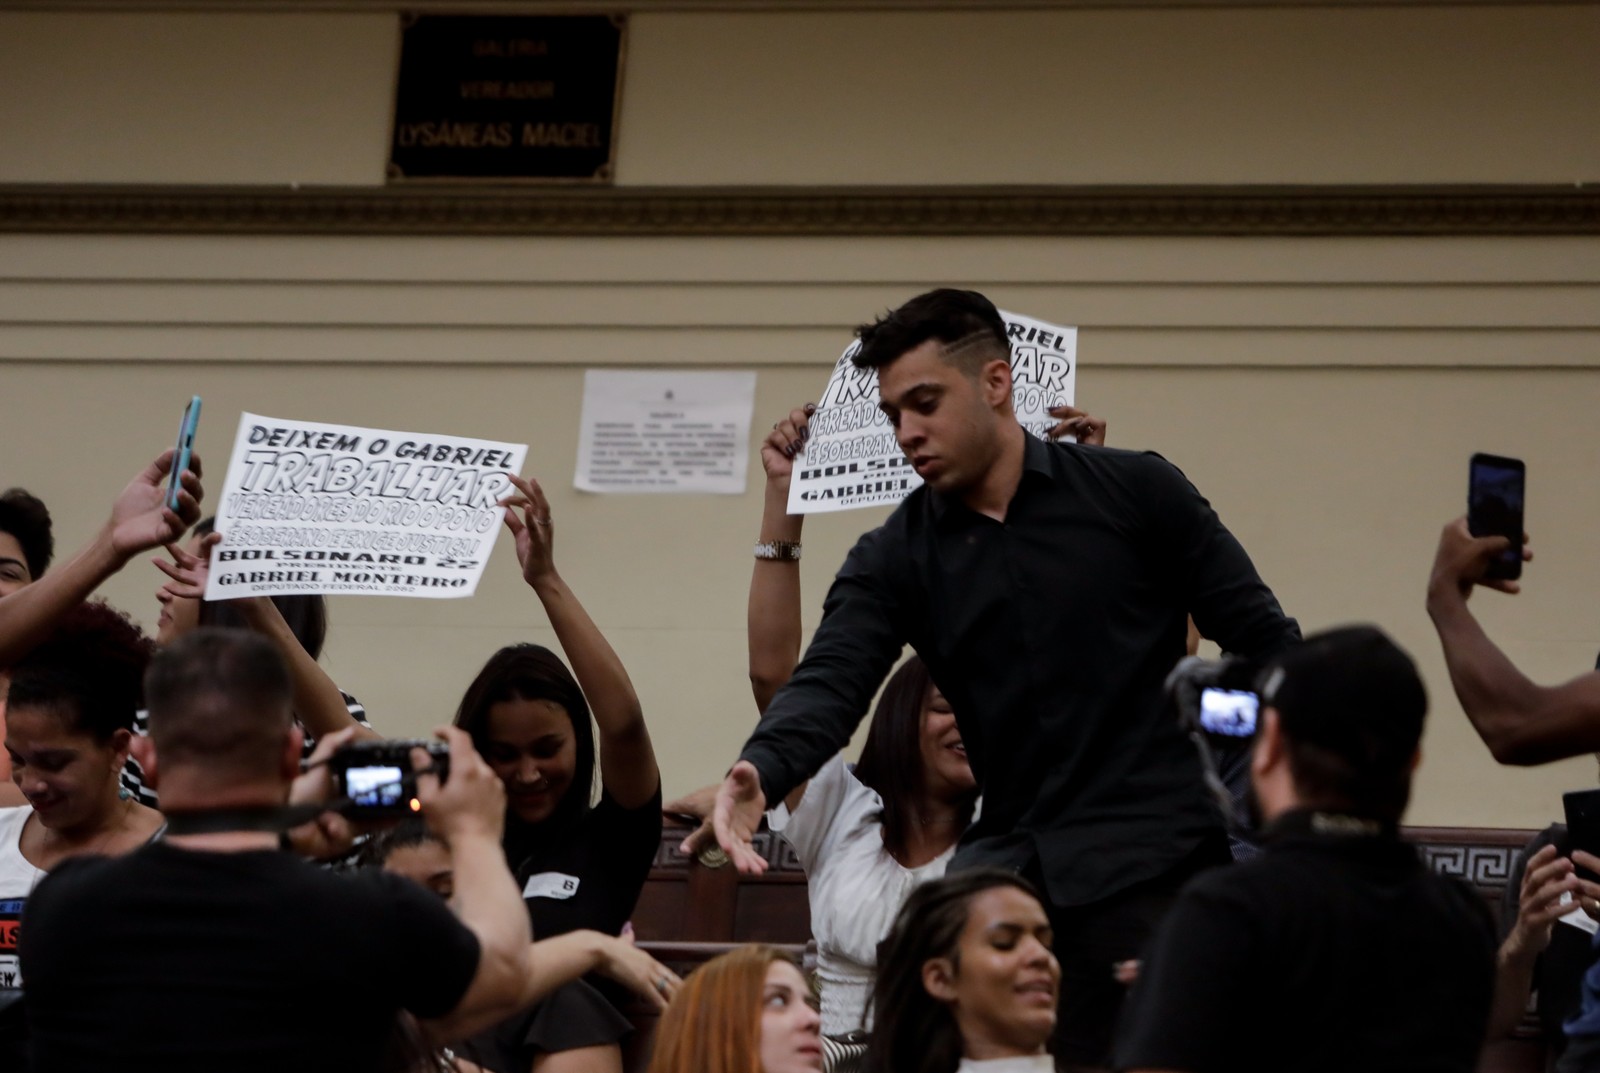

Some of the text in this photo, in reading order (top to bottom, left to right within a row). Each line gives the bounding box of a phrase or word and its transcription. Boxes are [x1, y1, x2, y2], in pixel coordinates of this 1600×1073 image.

[522, 121, 603, 147] MACIEL
[248, 425, 513, 468] DEIXEM O GABRIEL
[240, 450, 510, 508] TRABALHAR
[800, 479, 913, 501] GABRIEL
[218, 550, 480, 569] BOLSONARO 22
[276, 562, 402, 571] PRESIDENTE
[218, 571, 468, 588] GABRIEL MONTEIRO
[251, 583, 320, 592] DEPUTADO
[322, 583, 381, 591] FEDERAL
